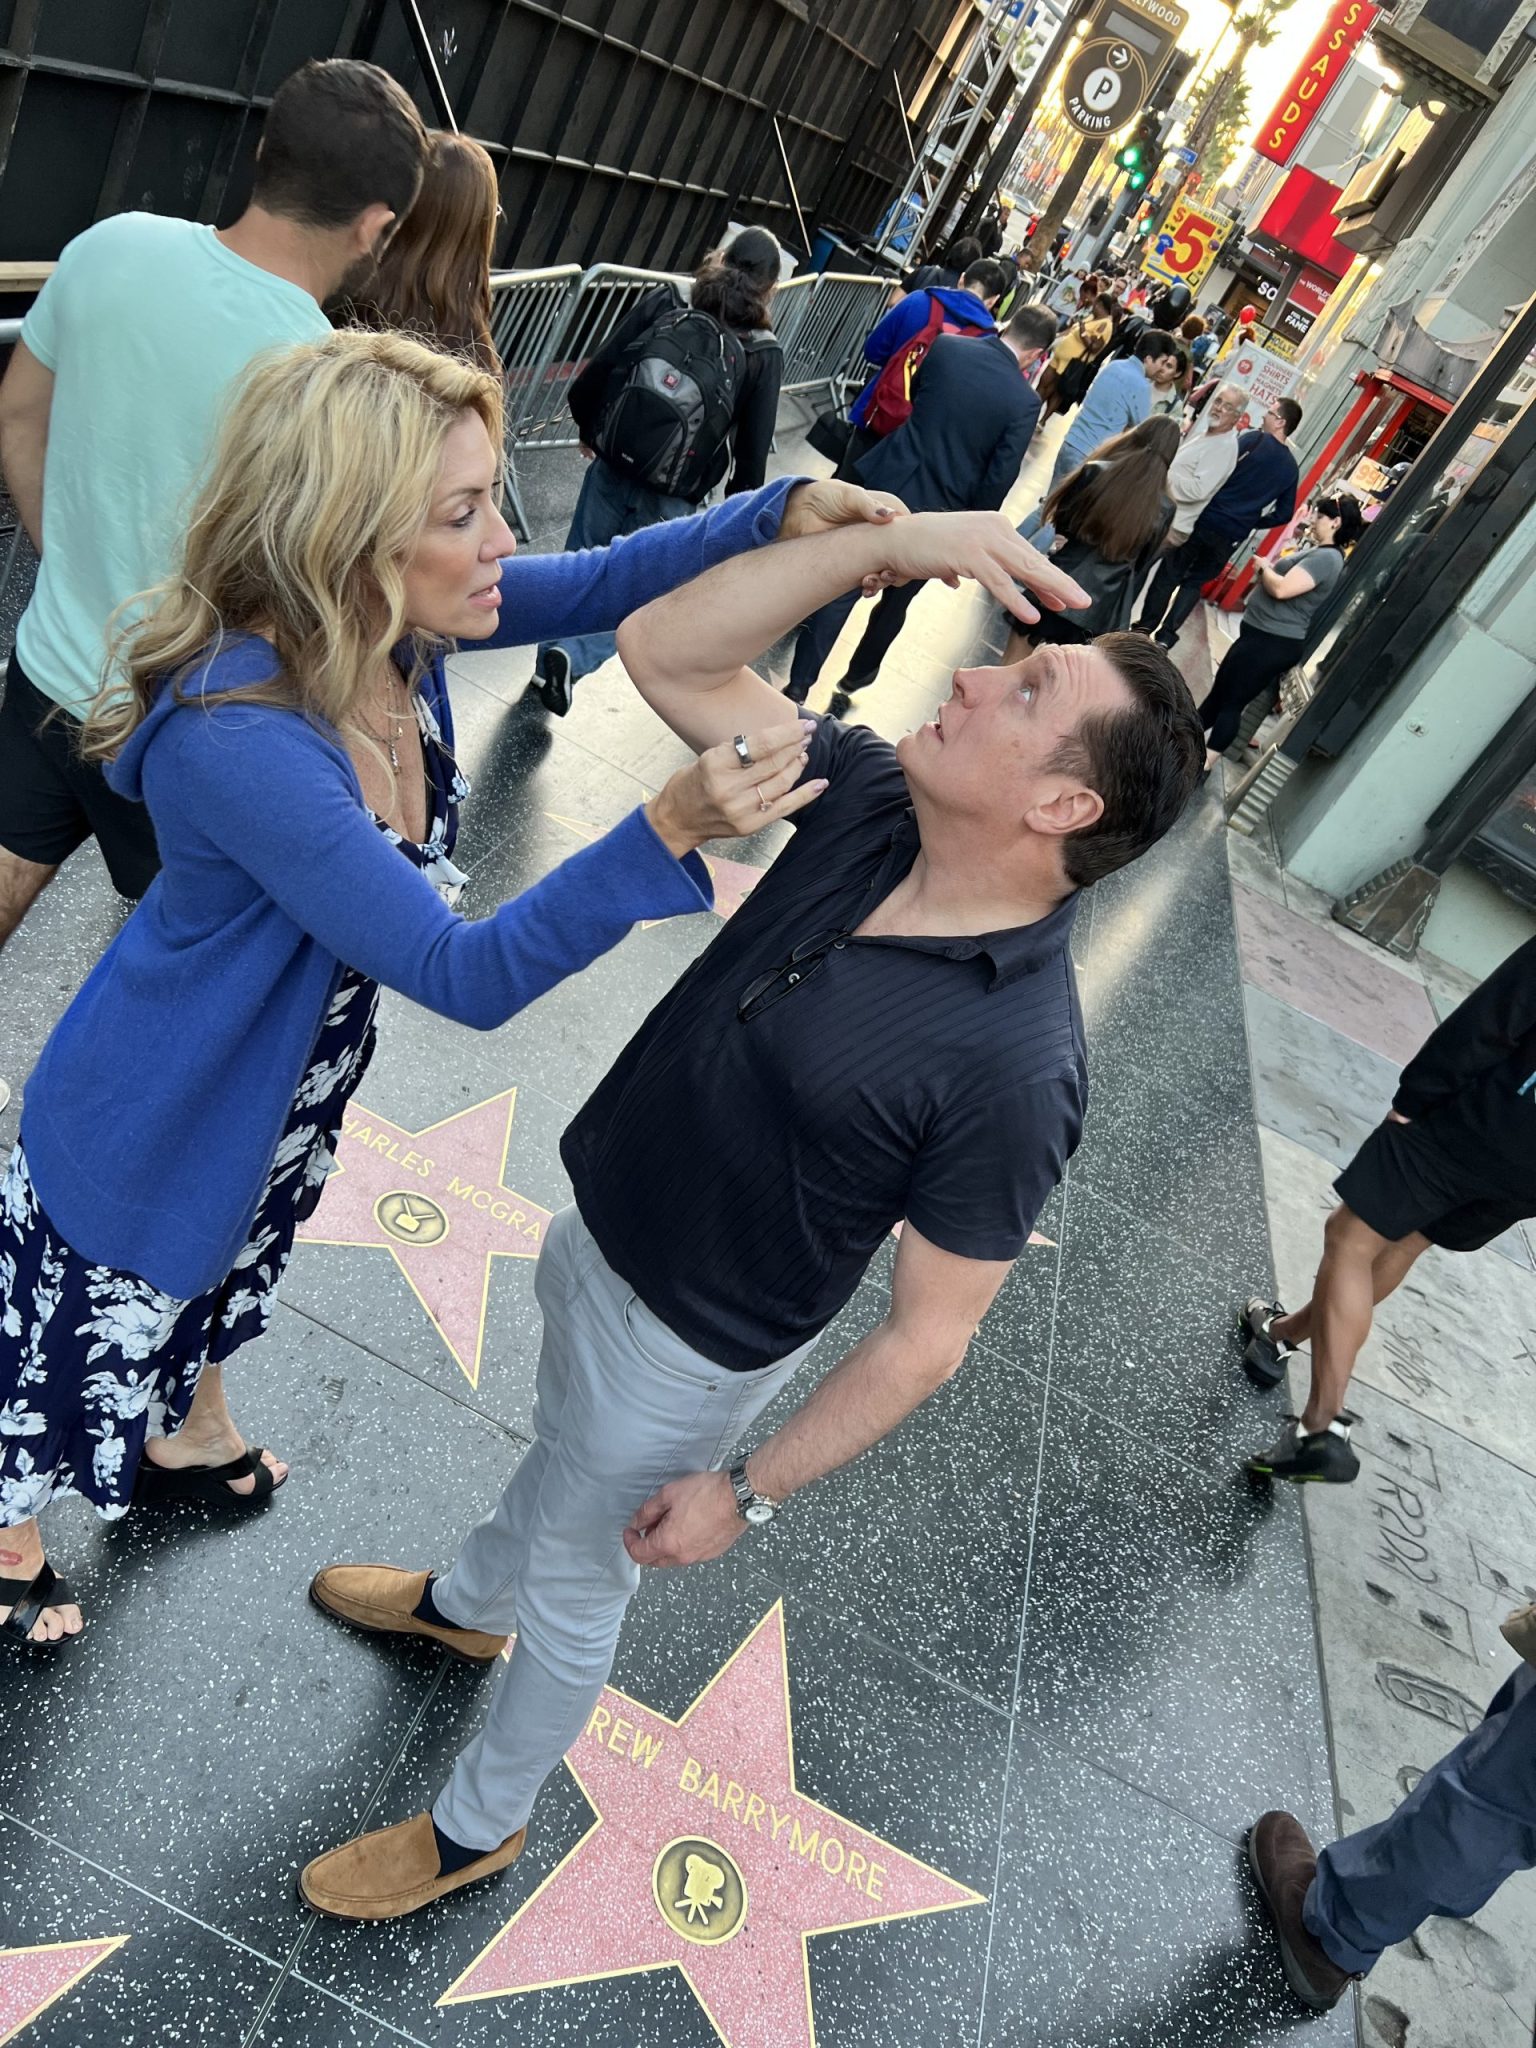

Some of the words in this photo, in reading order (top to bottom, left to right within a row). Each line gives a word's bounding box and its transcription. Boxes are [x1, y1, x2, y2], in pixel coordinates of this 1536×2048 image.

[1093, 76, 1113, 100] P
[1069, 97, 1111, 128] PARKING
[1285, 315, 1308, 333] FAME
[1262, 364, 1290, 385] SHIRTS
[1249, 383, 1278, 405] HATS
[344, 1115, 436, 1177] HARLES
[447, 1176, 541, 1241] MCGRA
[586, 1705, 663, 1768] REW
[679, 1757, 887, 1902] BARRYMORE
